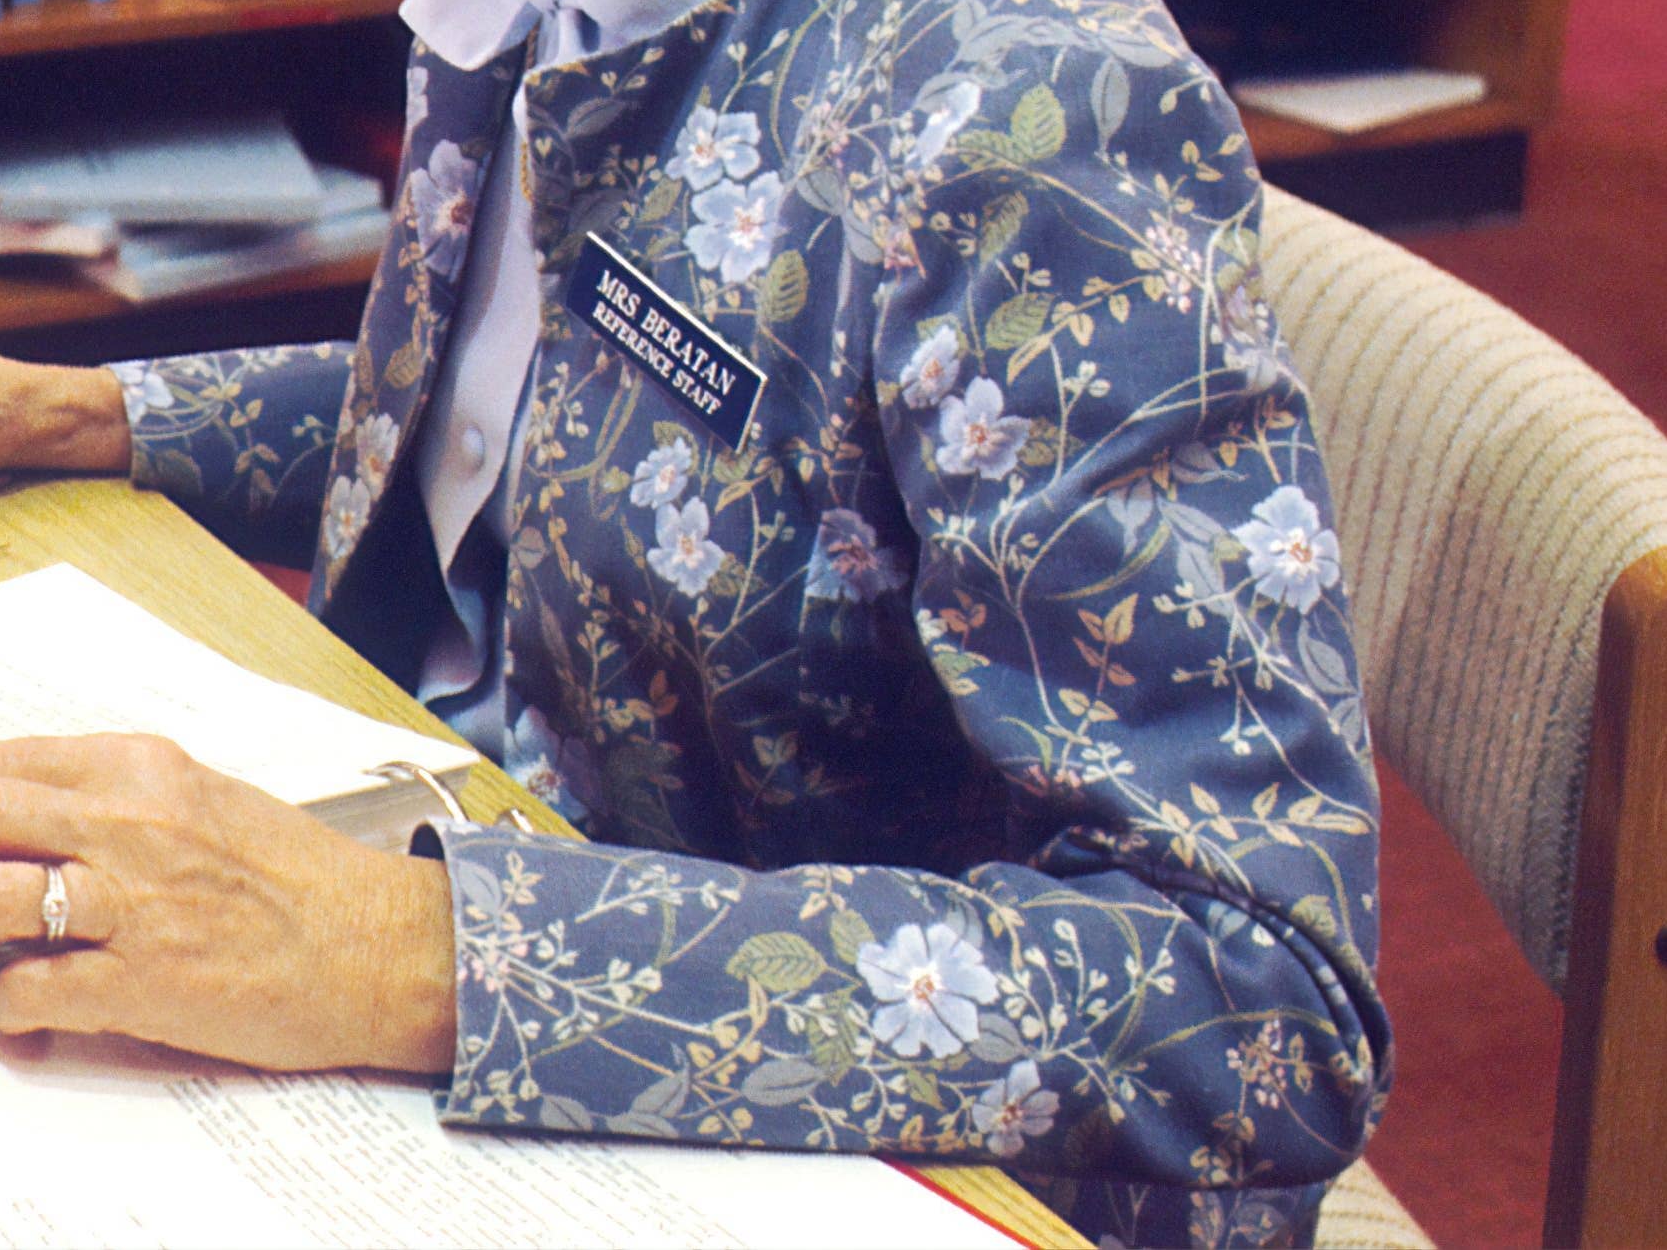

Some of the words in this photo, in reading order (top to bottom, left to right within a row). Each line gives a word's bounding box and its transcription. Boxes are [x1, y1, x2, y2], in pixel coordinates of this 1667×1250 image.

[592, 301, 674, 378] REFERENCE
[672, 368, 722, 415] STAFF
[595, 269, 641, 319] MRS
[640, 307, 736, 396] BERATAN
